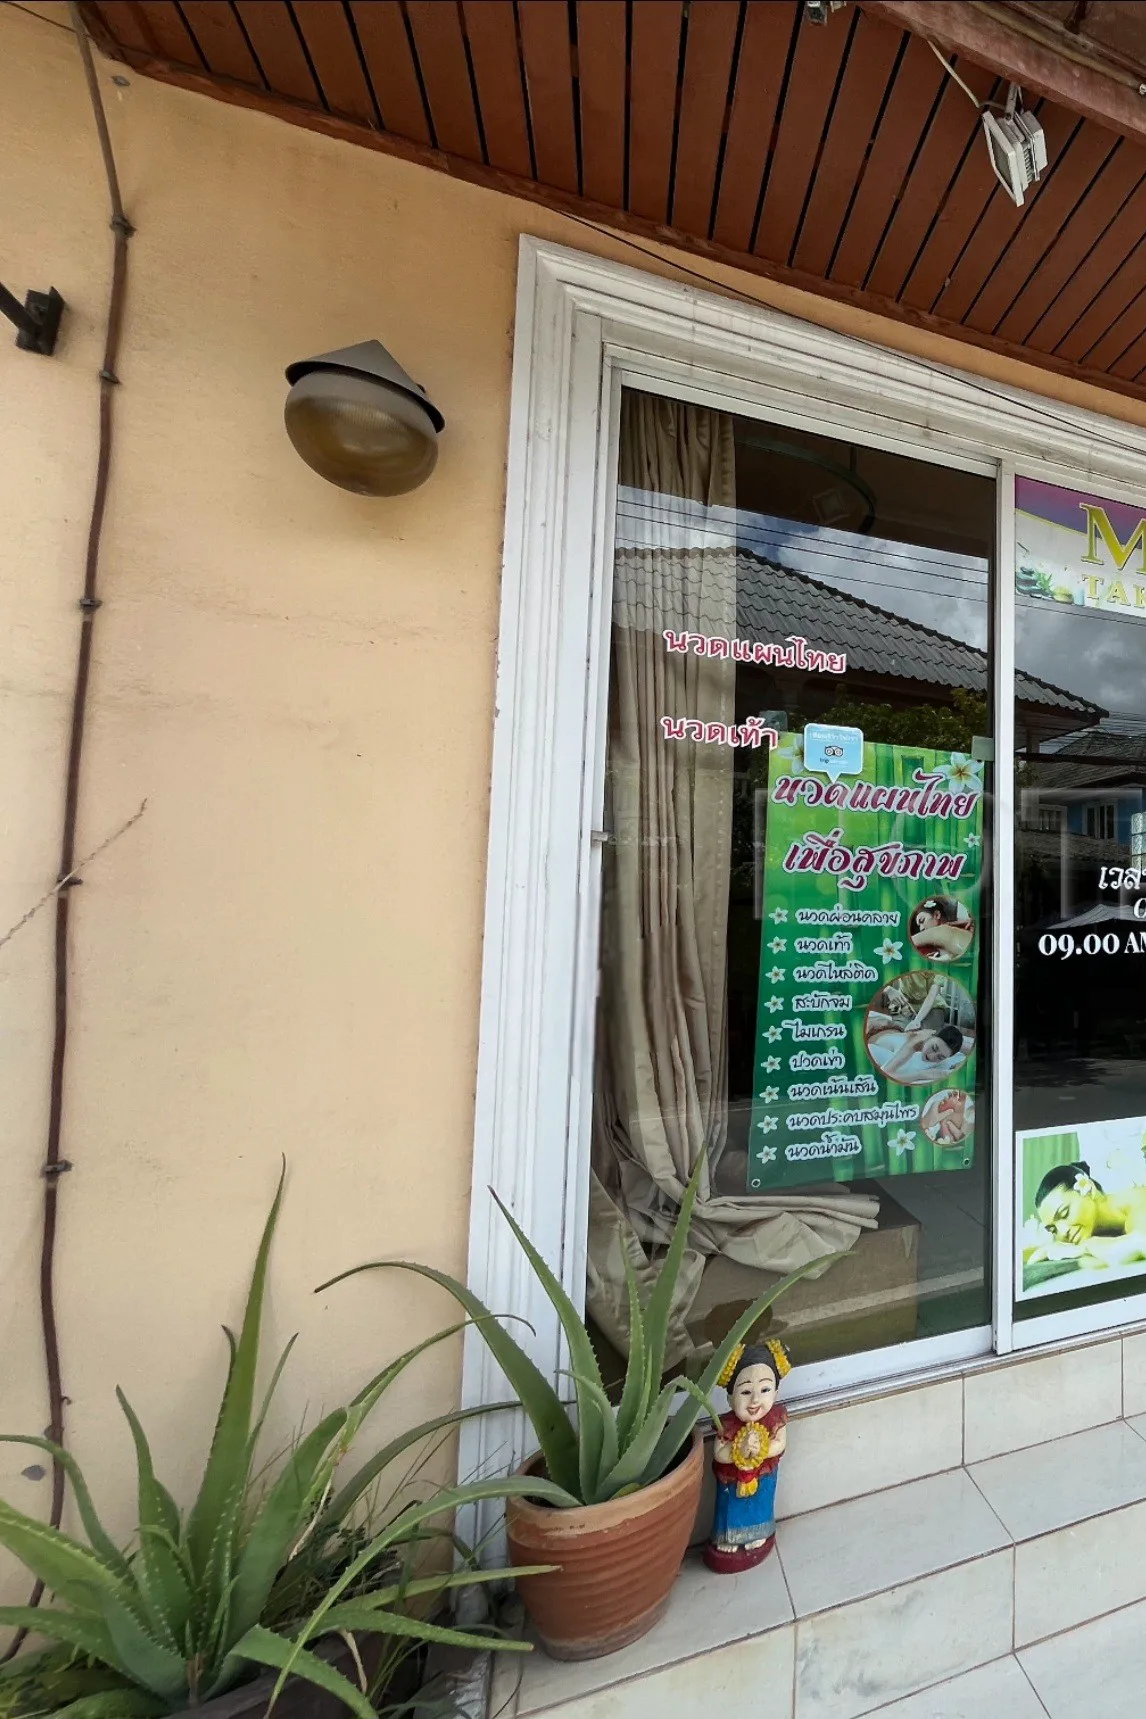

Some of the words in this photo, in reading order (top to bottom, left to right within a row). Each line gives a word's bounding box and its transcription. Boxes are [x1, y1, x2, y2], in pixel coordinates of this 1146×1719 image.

[662, 629, 846, 674] นวดแผนไทย
[661, 715, 779, 750] นวดเท้า
[772, 768, 981, 819] นวดแผนไทย
[783, 828, 968, 892] เพื่อสุขภาพ
[796, 905, 899, 926] นวดผ่อนคลาย
[796, 933, 852, 952] นวดเท้า
[1038, 932, 1120, 961] 09.00
[795, 961, 877, 981] นวดไหล่ติด
[794, 992, 851, 1011] สะบักจม
[784, 1020, 845, 1040] ไมเกรน
[791, 1048, 844, 1069] ปวดเข่า
[789, 1076, 877, 1099] นวดเน้นเส้น
[788, 1103, 918, 1128] นวดประคบสมุนไพร
[787, 1133, 860, 1159] นวดน้ำมัน
